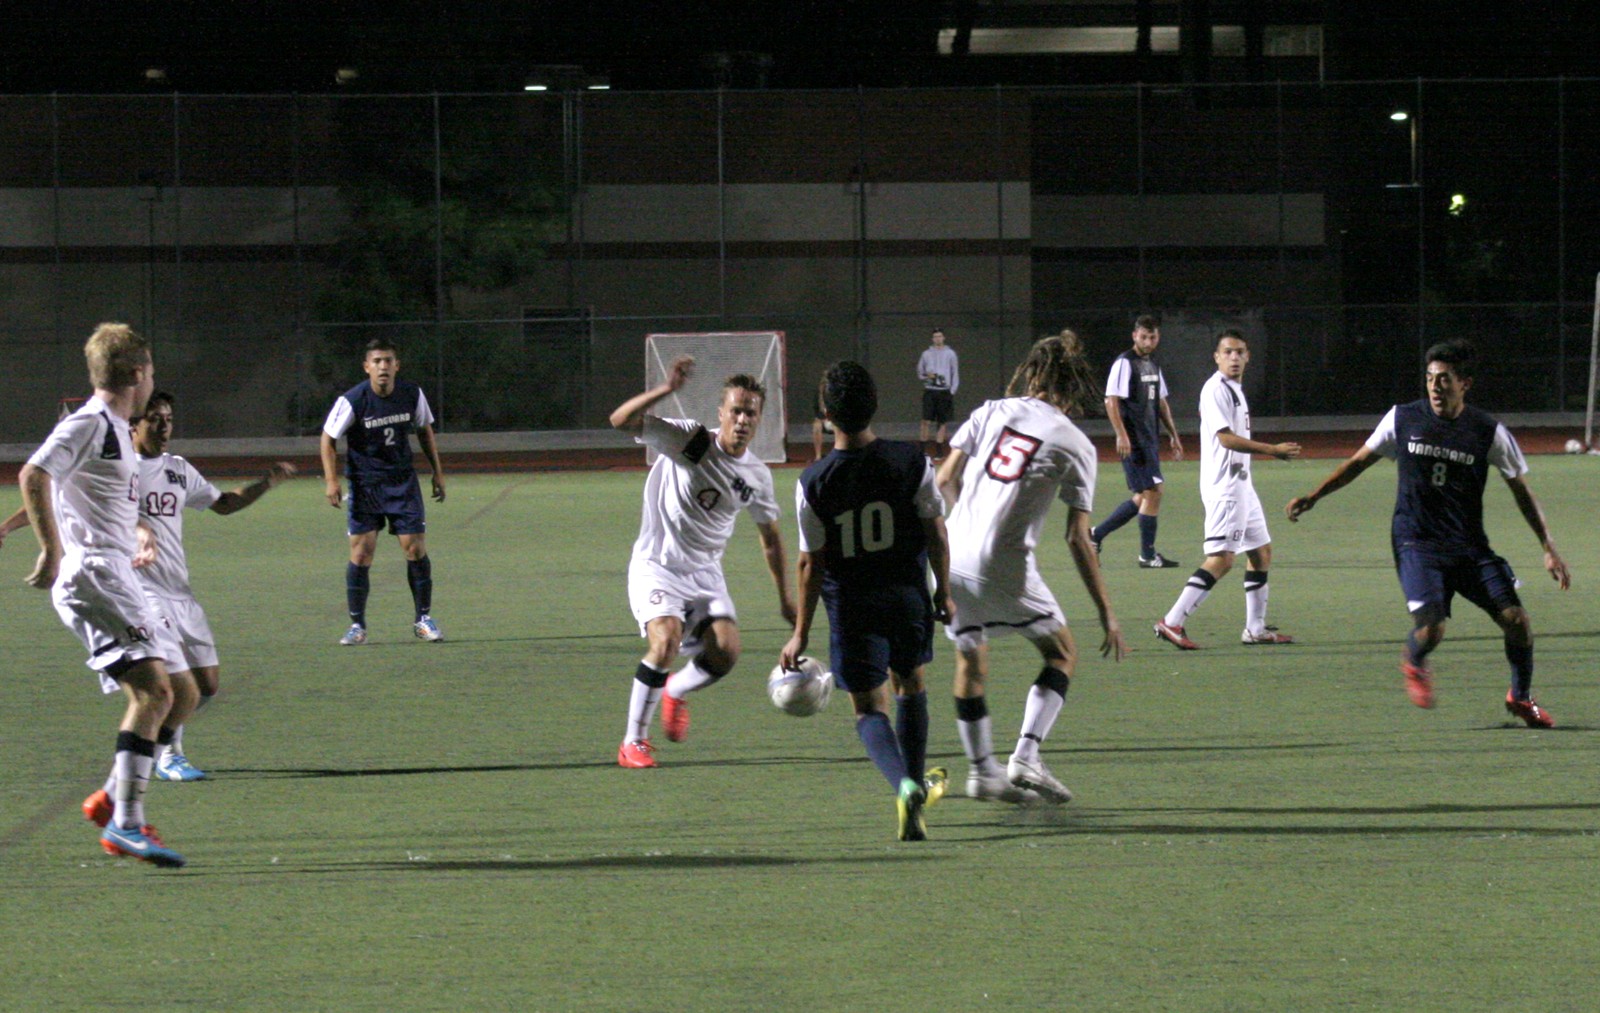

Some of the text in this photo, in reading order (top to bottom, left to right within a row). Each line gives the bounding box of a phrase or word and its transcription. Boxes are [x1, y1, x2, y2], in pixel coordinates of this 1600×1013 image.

[365, 413, 410, 429] VANGUARD
[383, 427, 396, 446] 2
[985, 425, 1044, 484] 5
[1407, 442, 1475, 465] VANGUARD
[164, 469, 187, 490] BU
[1431, 462, 1447, 487] 8
[146, 492, 177, 517] 12
[834, 501, 895, 558] 10
